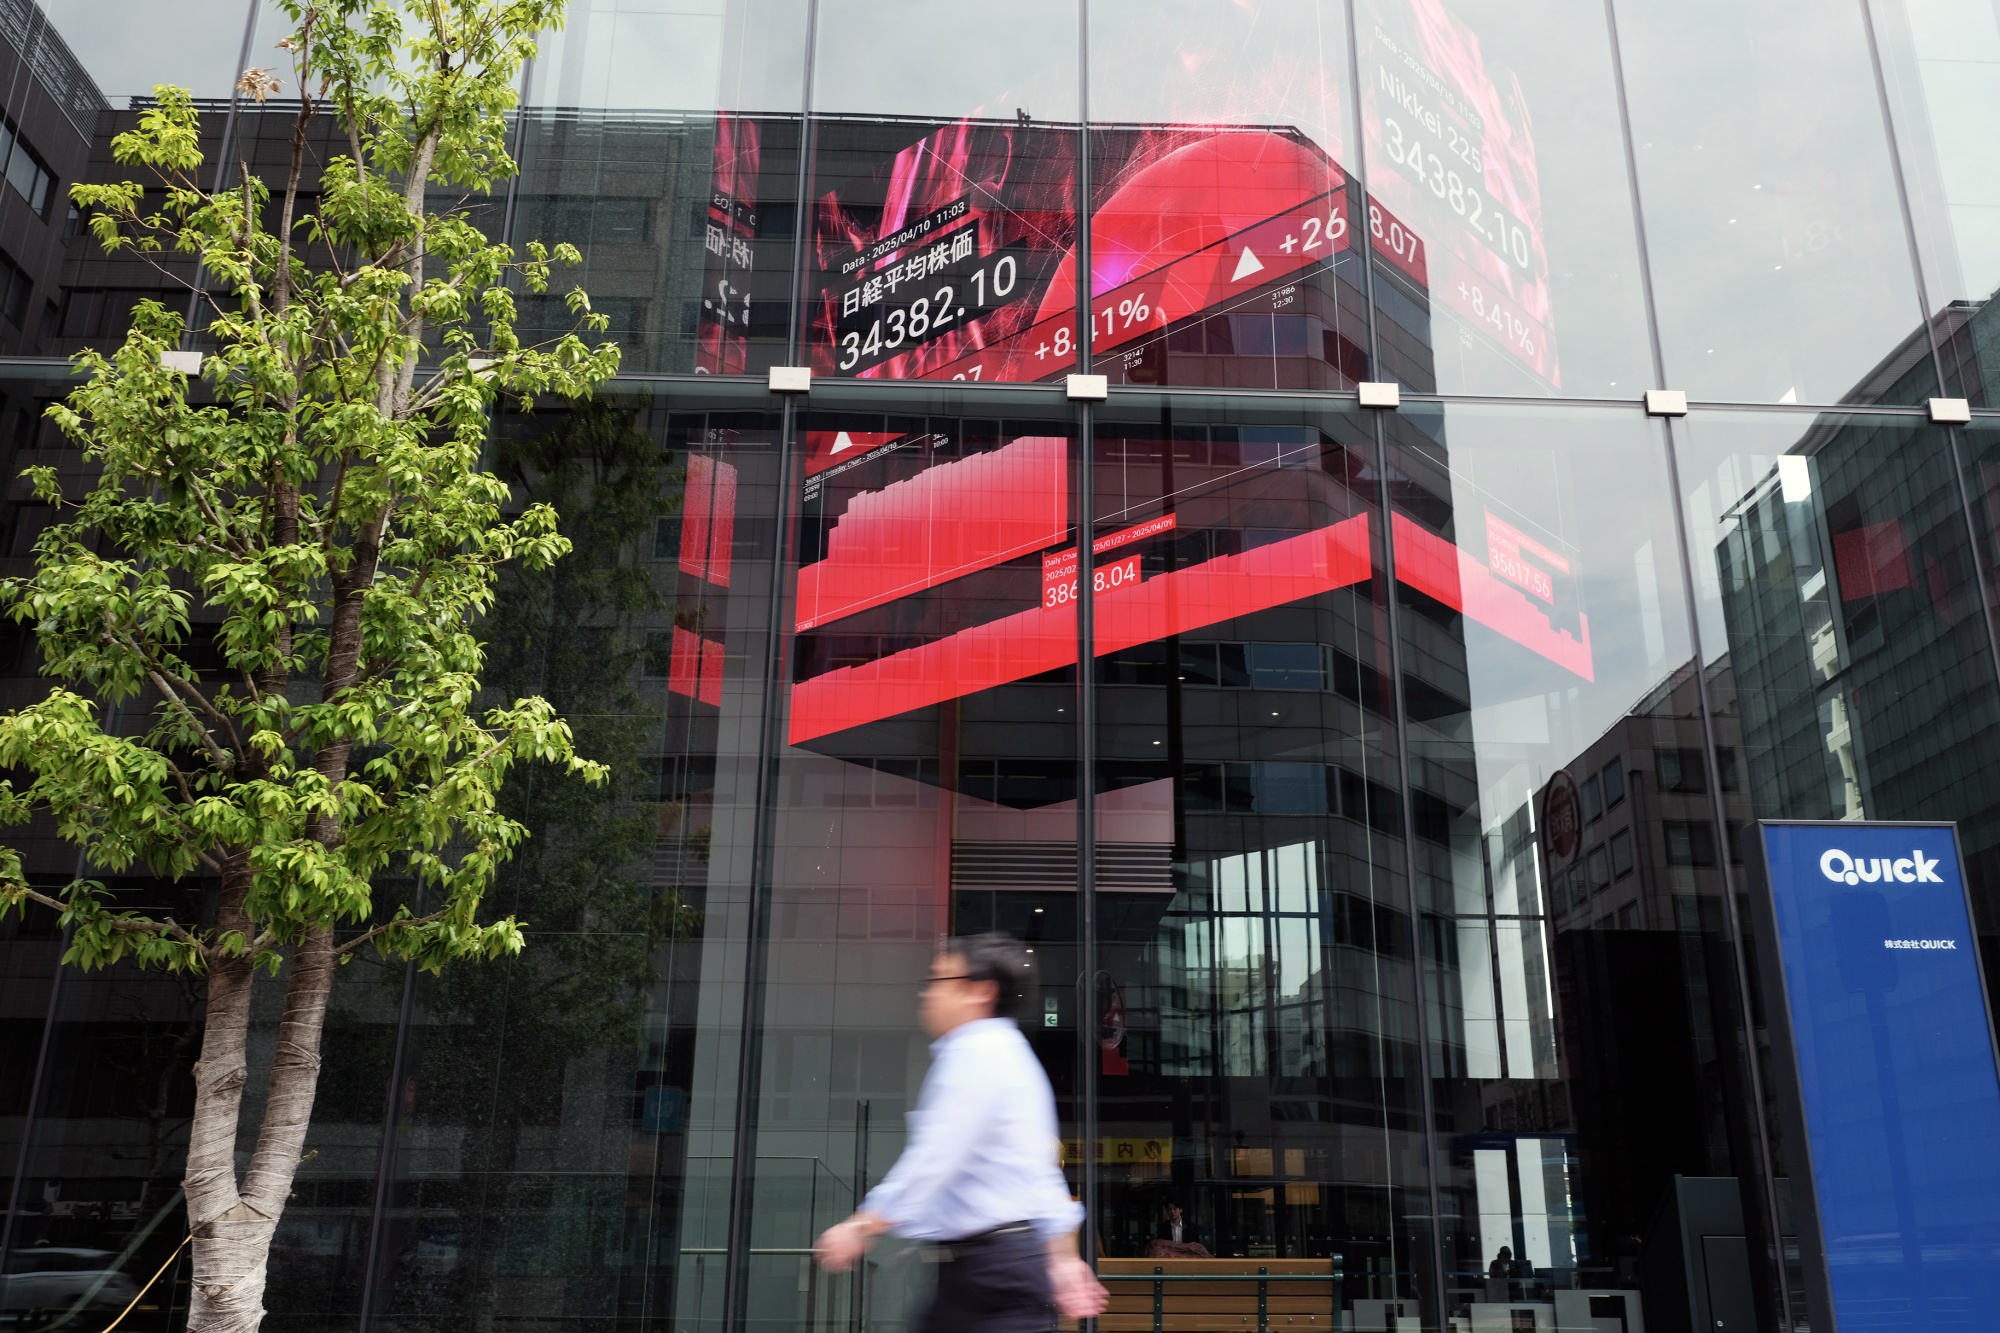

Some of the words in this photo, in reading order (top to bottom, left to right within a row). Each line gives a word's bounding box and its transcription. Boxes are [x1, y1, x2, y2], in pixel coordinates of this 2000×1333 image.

[1375, 25, 1397, 53] Data
[1404, 52, 1455, 105] 2025/04/10
[1458, 102, 1481, 130] 11:03
[1379, 64, 1443, 140] Nikkei
[1448, 126, 1482, 173] 225
[1385, 117, 1530, 269] 34382.10
[842, 255, 866, 275] Data
[872, 220, 931, 258] 2025/04/10
[936, 202, 965, 223] 11:03
[843, 229, 974, 318] 日経平均株価
[1272, 285, 1296, 300] 31986
[1273, 295, 1294, 309] 12:30
[839, 255, 1017, 371] 34382.10
[1034, 292, 1150, 361] +8.1%
[1457, 280, 1535, 356] +8.41%
[1123, 347, 1144, 362] 32147
[1124, 357, 1143, 370] 11:30
[1045, 556, 1061, 568] Daily
[1062, 552, 1077, 562] Char
[1132, 518, 1173, 539] 2025/04/09
[1045, 564, 1077, 582] 2025/02
[1490, 547, 1551, 598] 35617.56
[1045, 561, 1136, 608] 3868.04
